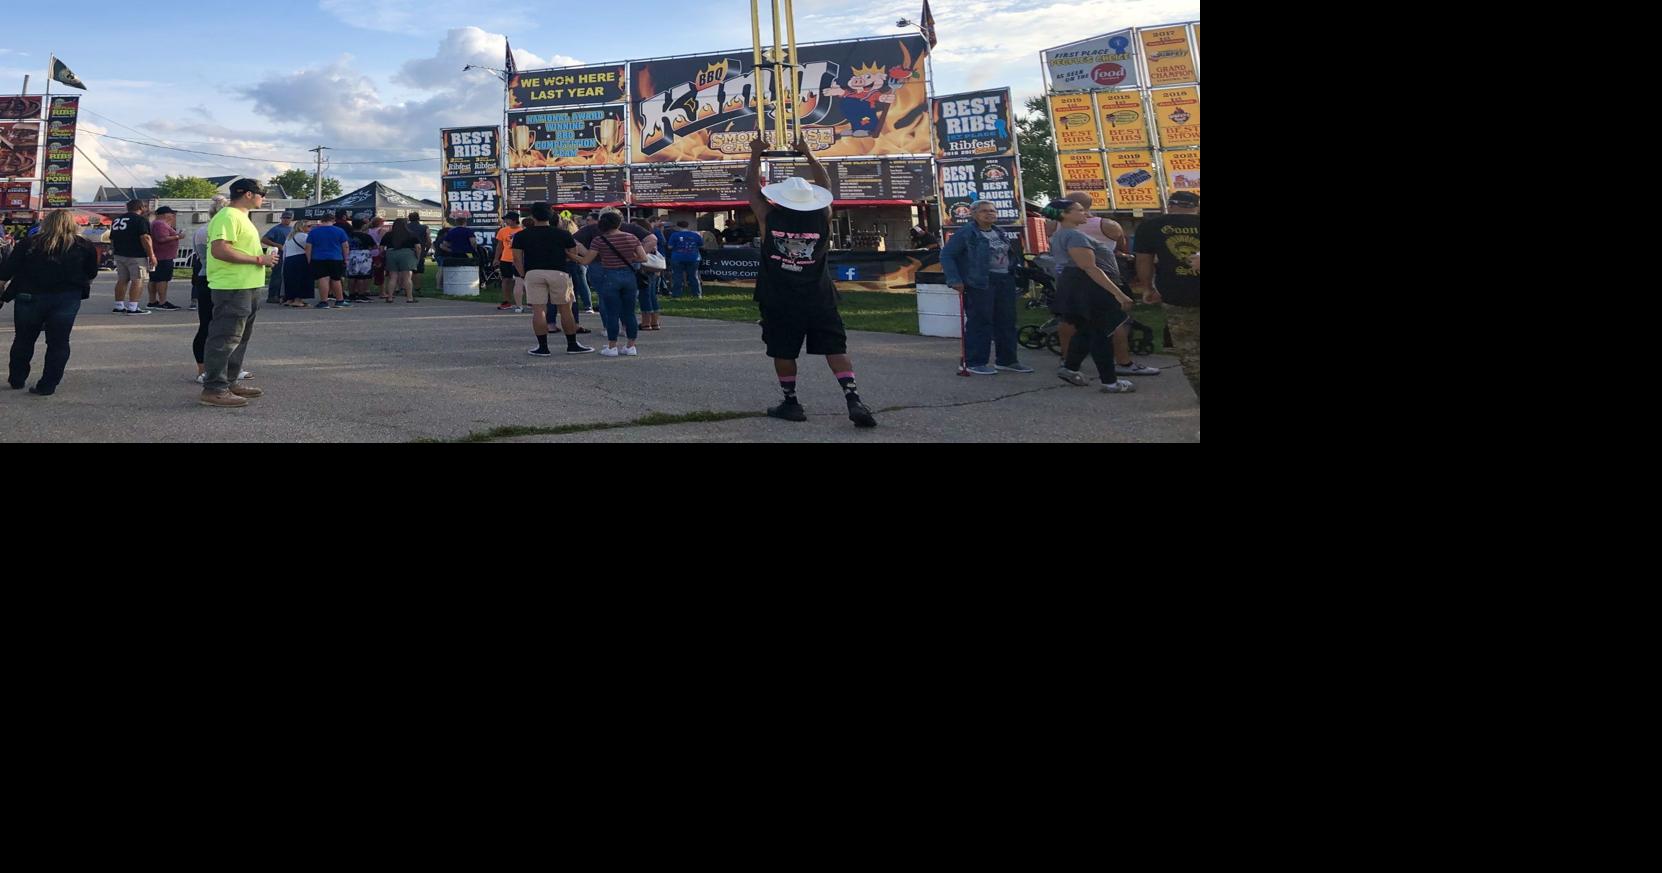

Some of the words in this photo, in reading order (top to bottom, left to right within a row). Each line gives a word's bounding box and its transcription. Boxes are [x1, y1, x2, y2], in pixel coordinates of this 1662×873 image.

[521, 78, 540, 88] WE
[544, 76, 574, 86] WON
[579, 72, 615, 84] HERE
[700, 66, 723, 86] BBQ
[1094, 66, 1125, 81] food
[530, 89, 564, 100] LAST
[568, 87, 604, 98] YEAR
[942, 96, 1000, 118] BEST
[526, 113, 570, 124] NATIONAL
[572, 110, 605, 121] AWARD
[545, 122, 585, 132] WINNING
[946, 114, 998, 134] RIBS
[451, 131, 493, 145] BEST
[535, 138, 597, 150] COMPETITION
[949, 139, 996, 150] Ribfest
[454, 144, 491, 157] RIBS
[943, 165, 975, 181] BEST
[944, 181, 977, 198] RIBS
[983, 182, 1008, 190] BEST
[448, 191, 496, 201] BEST
[979, 191, 1014, 199] SAUCE!
[450, 201, 494, 212] RIBS
[112, 218, 130, 230] 25
